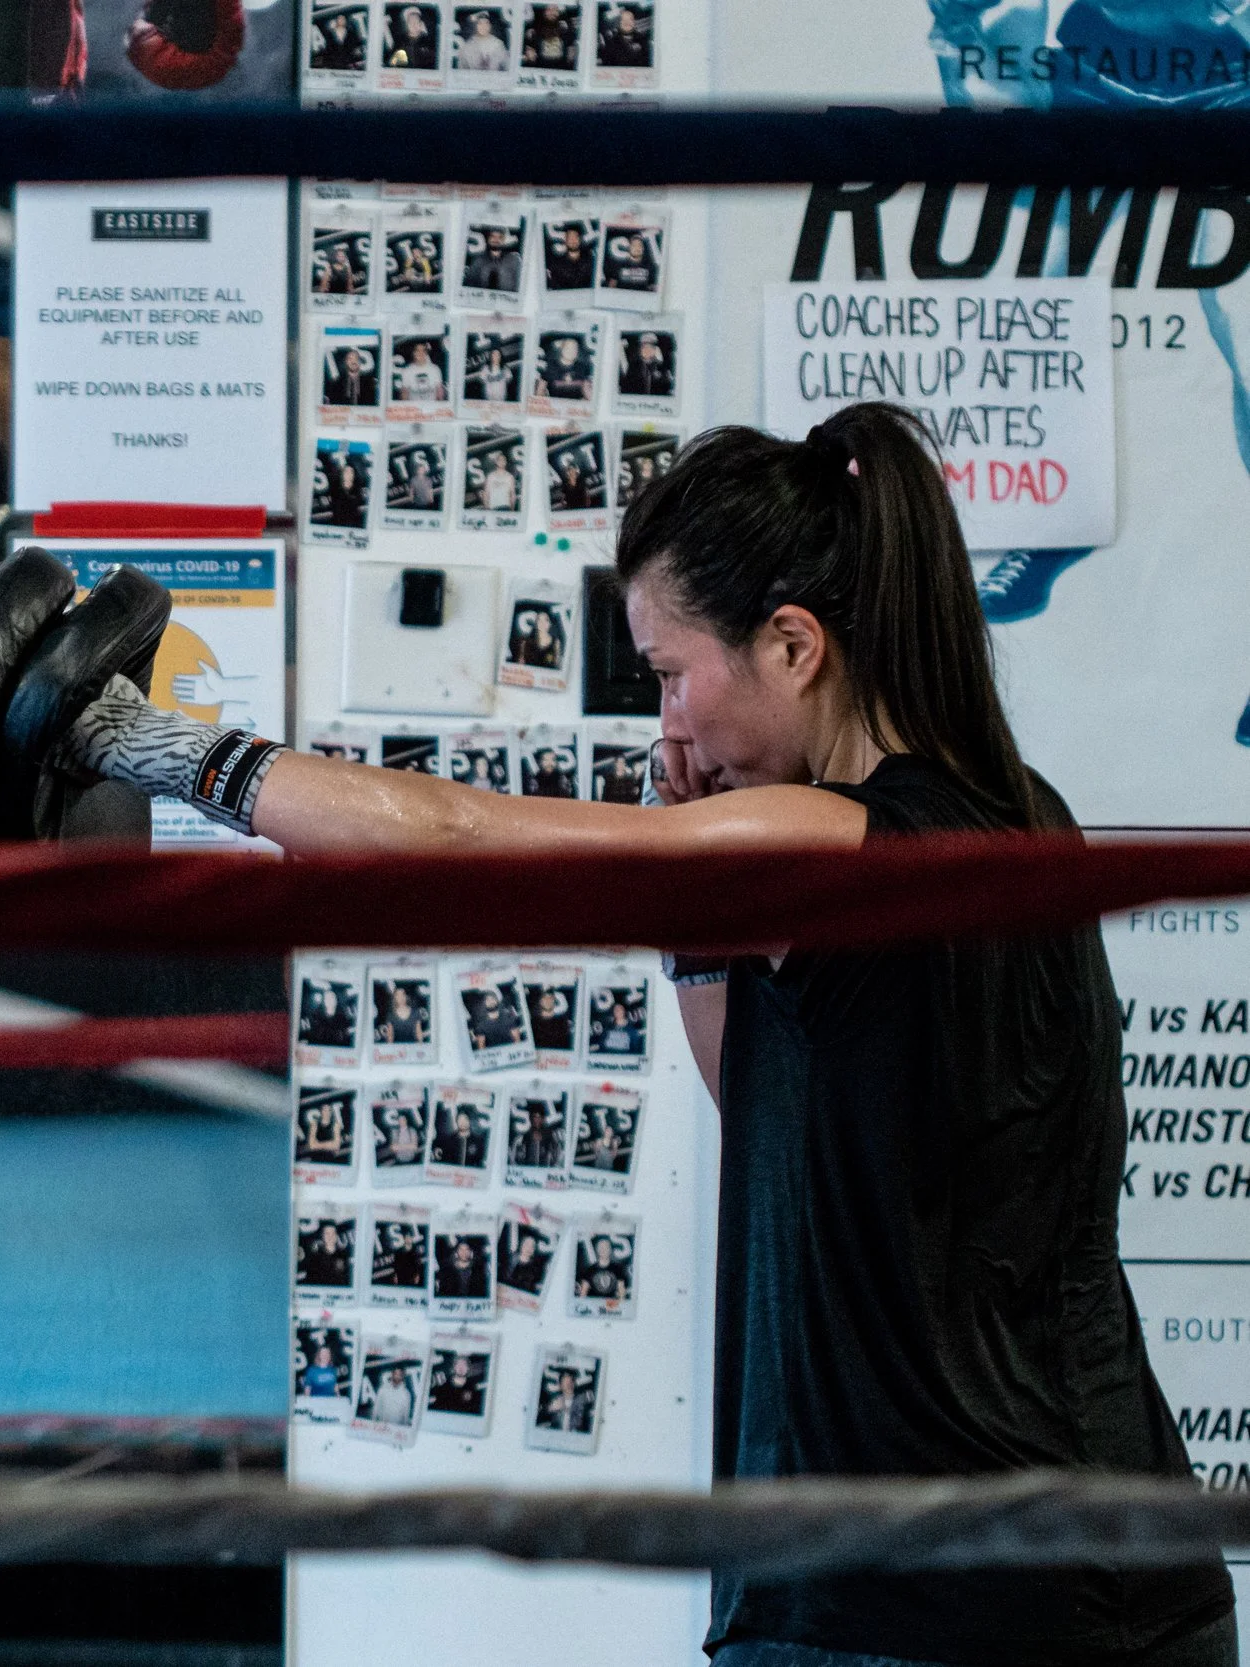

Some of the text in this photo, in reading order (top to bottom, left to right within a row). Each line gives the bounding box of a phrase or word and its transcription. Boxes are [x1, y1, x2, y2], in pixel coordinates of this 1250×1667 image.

[959, 45, 1250, 82] RESTAURA
[104, 213, 199, 229] EASTSIDE
[56, 287, 246, 302] PLEASE SANITIZE ALL
[38, 309, 264, 325] EQUIPMENT BEFORE AND
[796, 292, 1074, 342] COACHES PLEASE
[1111, 314, 1186, 349] 012
[101, 331, 199, 346] AFTER USE
[35, 382, 265, 397] WIPE DOWN BAGS & MATS
[800, 346, 1086, 401] CLEAN UP AFTER
[111, 432, 189, 447] THANKS!
[987, 458, 1068, 505] DAD
[87, 560, 240, 573] Corvirus COVID-19
[212, 741, 252, 804] MEISTER
[1130, 910, 1240, 934] FIGHTS
[1150, 1006, 1188, 1033] vs
[1201, 999, 1250, 1033] KA
[1121, 1054, 1250, 1088] OMANO
[1153, 1172, 1190, 1198] vs
[1205, 1164, 1250, 1198] CH
[1165, 1318, 1250, 1341] BOUT
[1179, 1408, 1250, 1441] MAR
